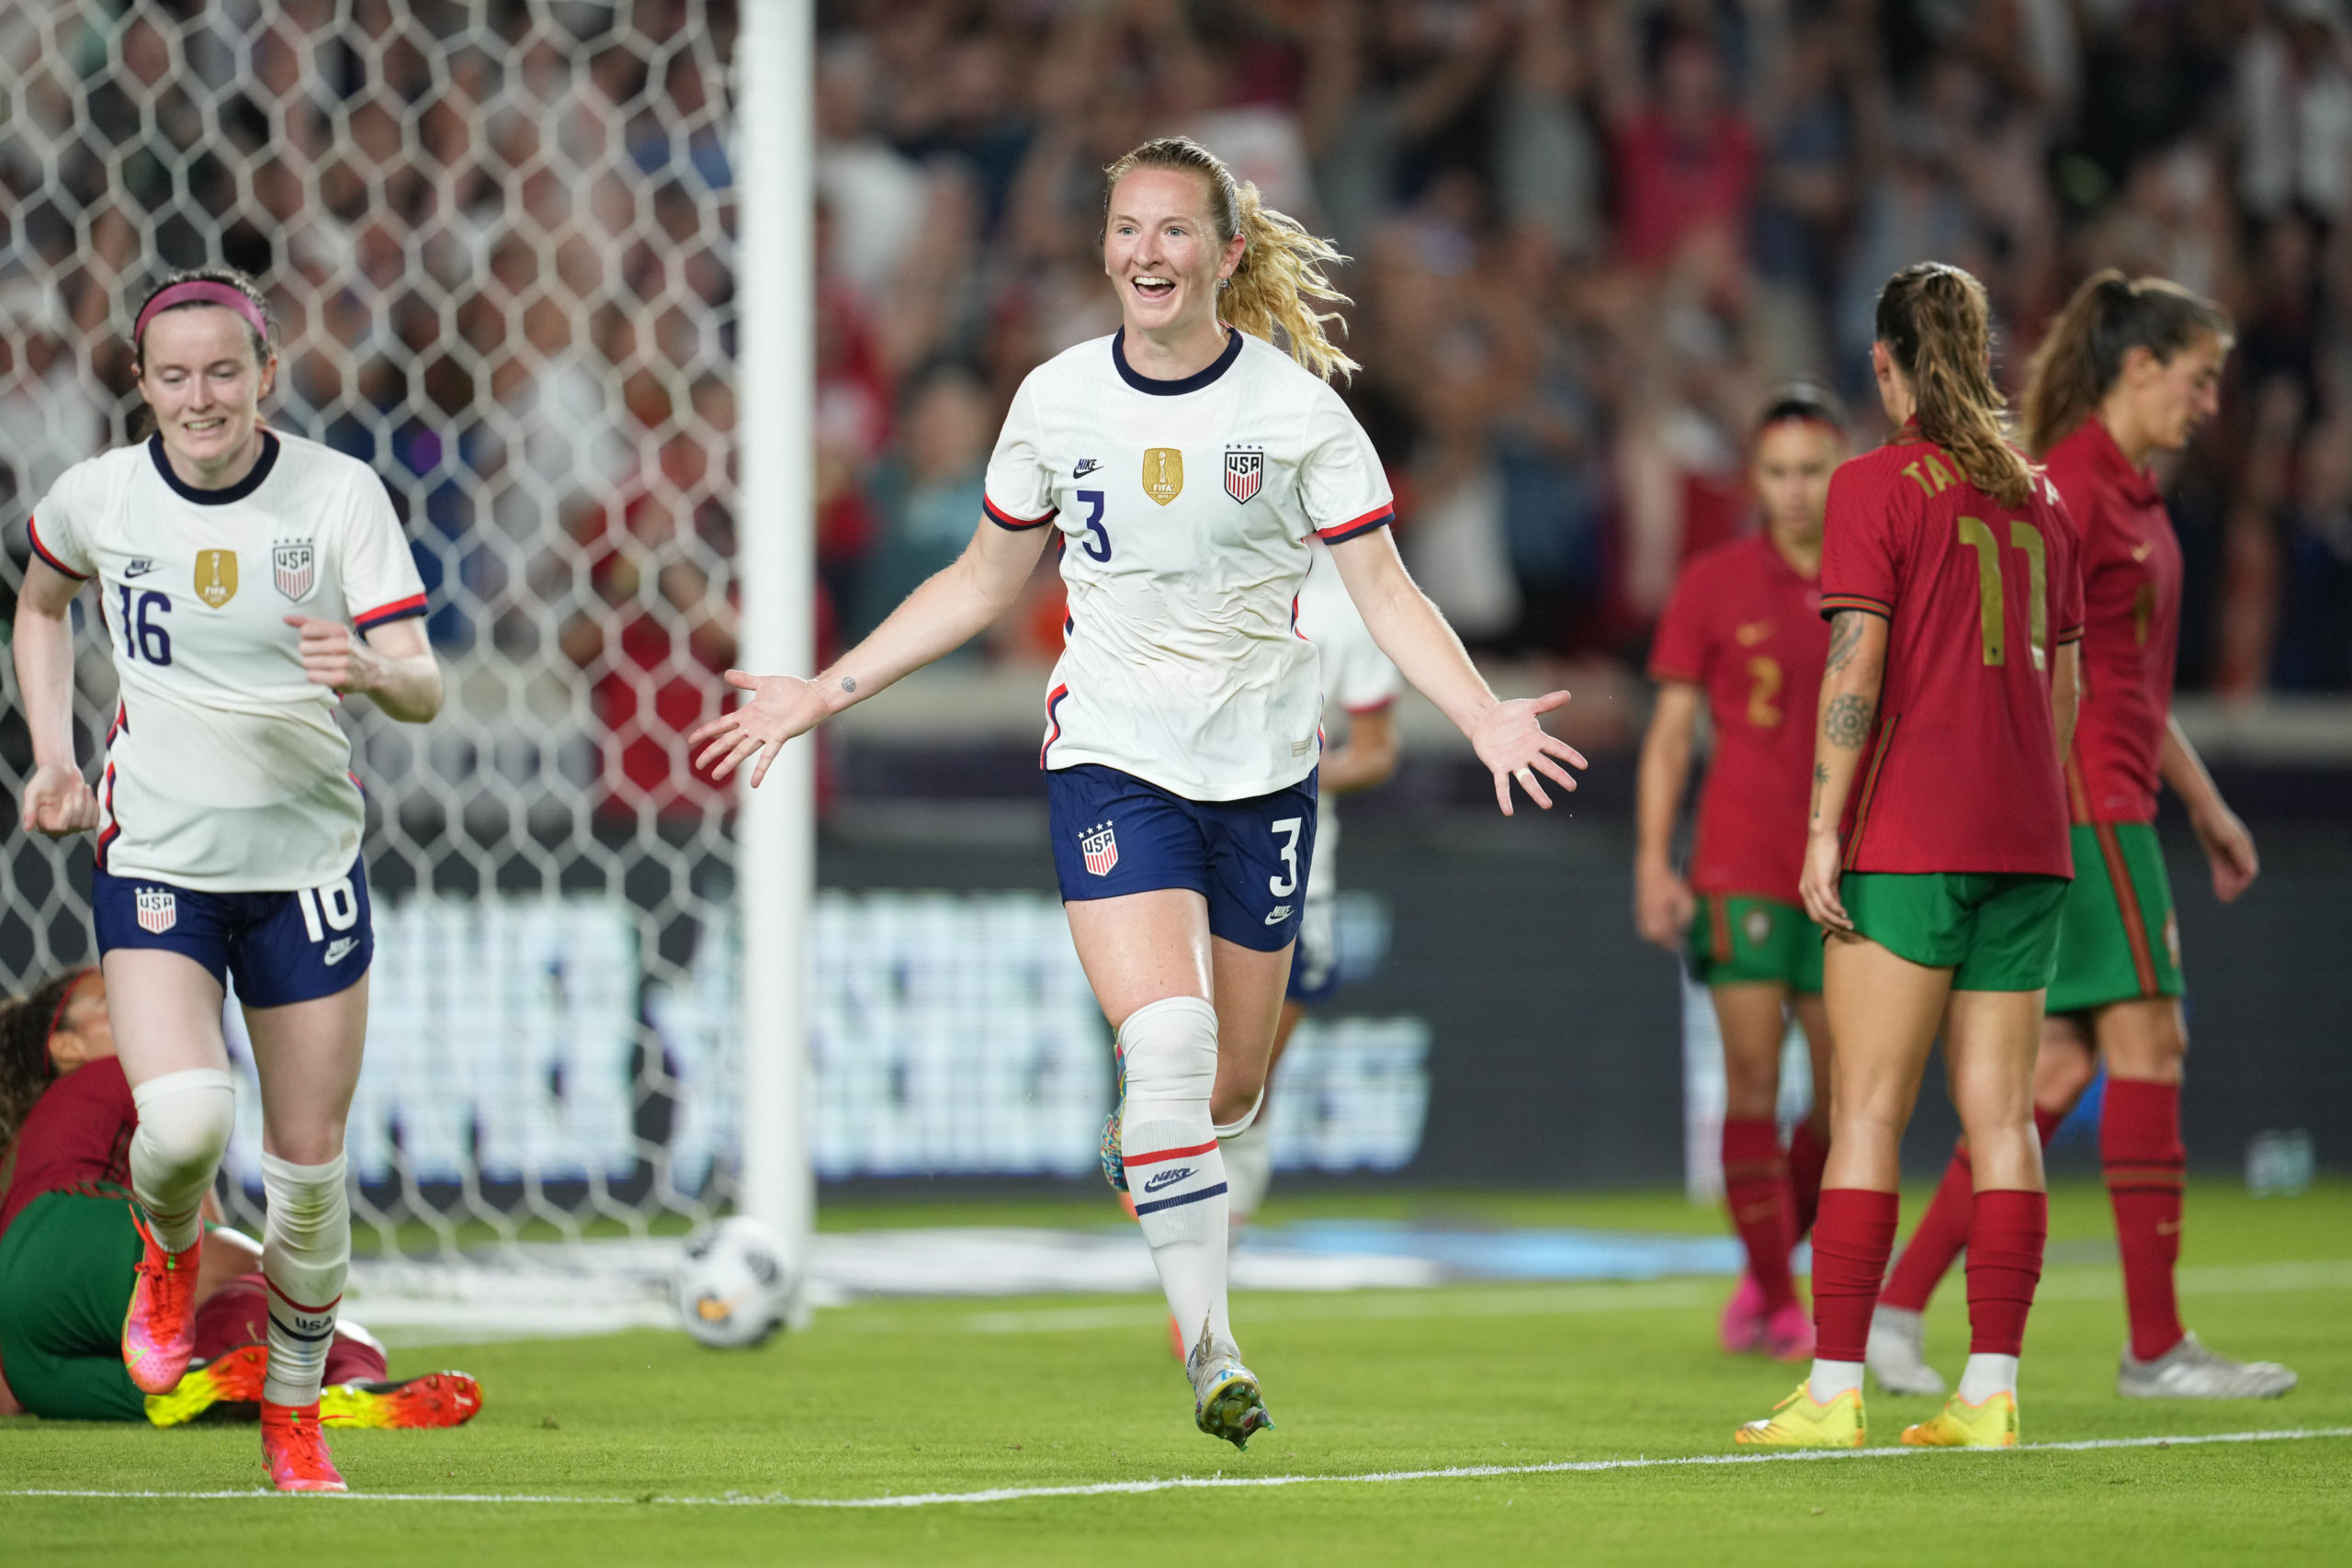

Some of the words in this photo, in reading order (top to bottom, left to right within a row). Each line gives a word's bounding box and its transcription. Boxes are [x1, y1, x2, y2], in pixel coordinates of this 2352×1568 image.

[1229, 457, 1260, 475] USA
[1153, 484, 1172, 492] FIFA
[1077, 490, 1112, 562] 3
[277, 551, 310, 570] USA
[205, 585, 227, 596] FIFA
[1958, 515, 2047, 671] 11
[119, 583, 172, 667] 16
[1747, 656, 1782, 729] 2
[1084, 831, 1113, 854] USA
[1269, 817, 1302, 897] 3
[140, 896, 173, 911] USA
[295, 1315, 332, 1331] USA
